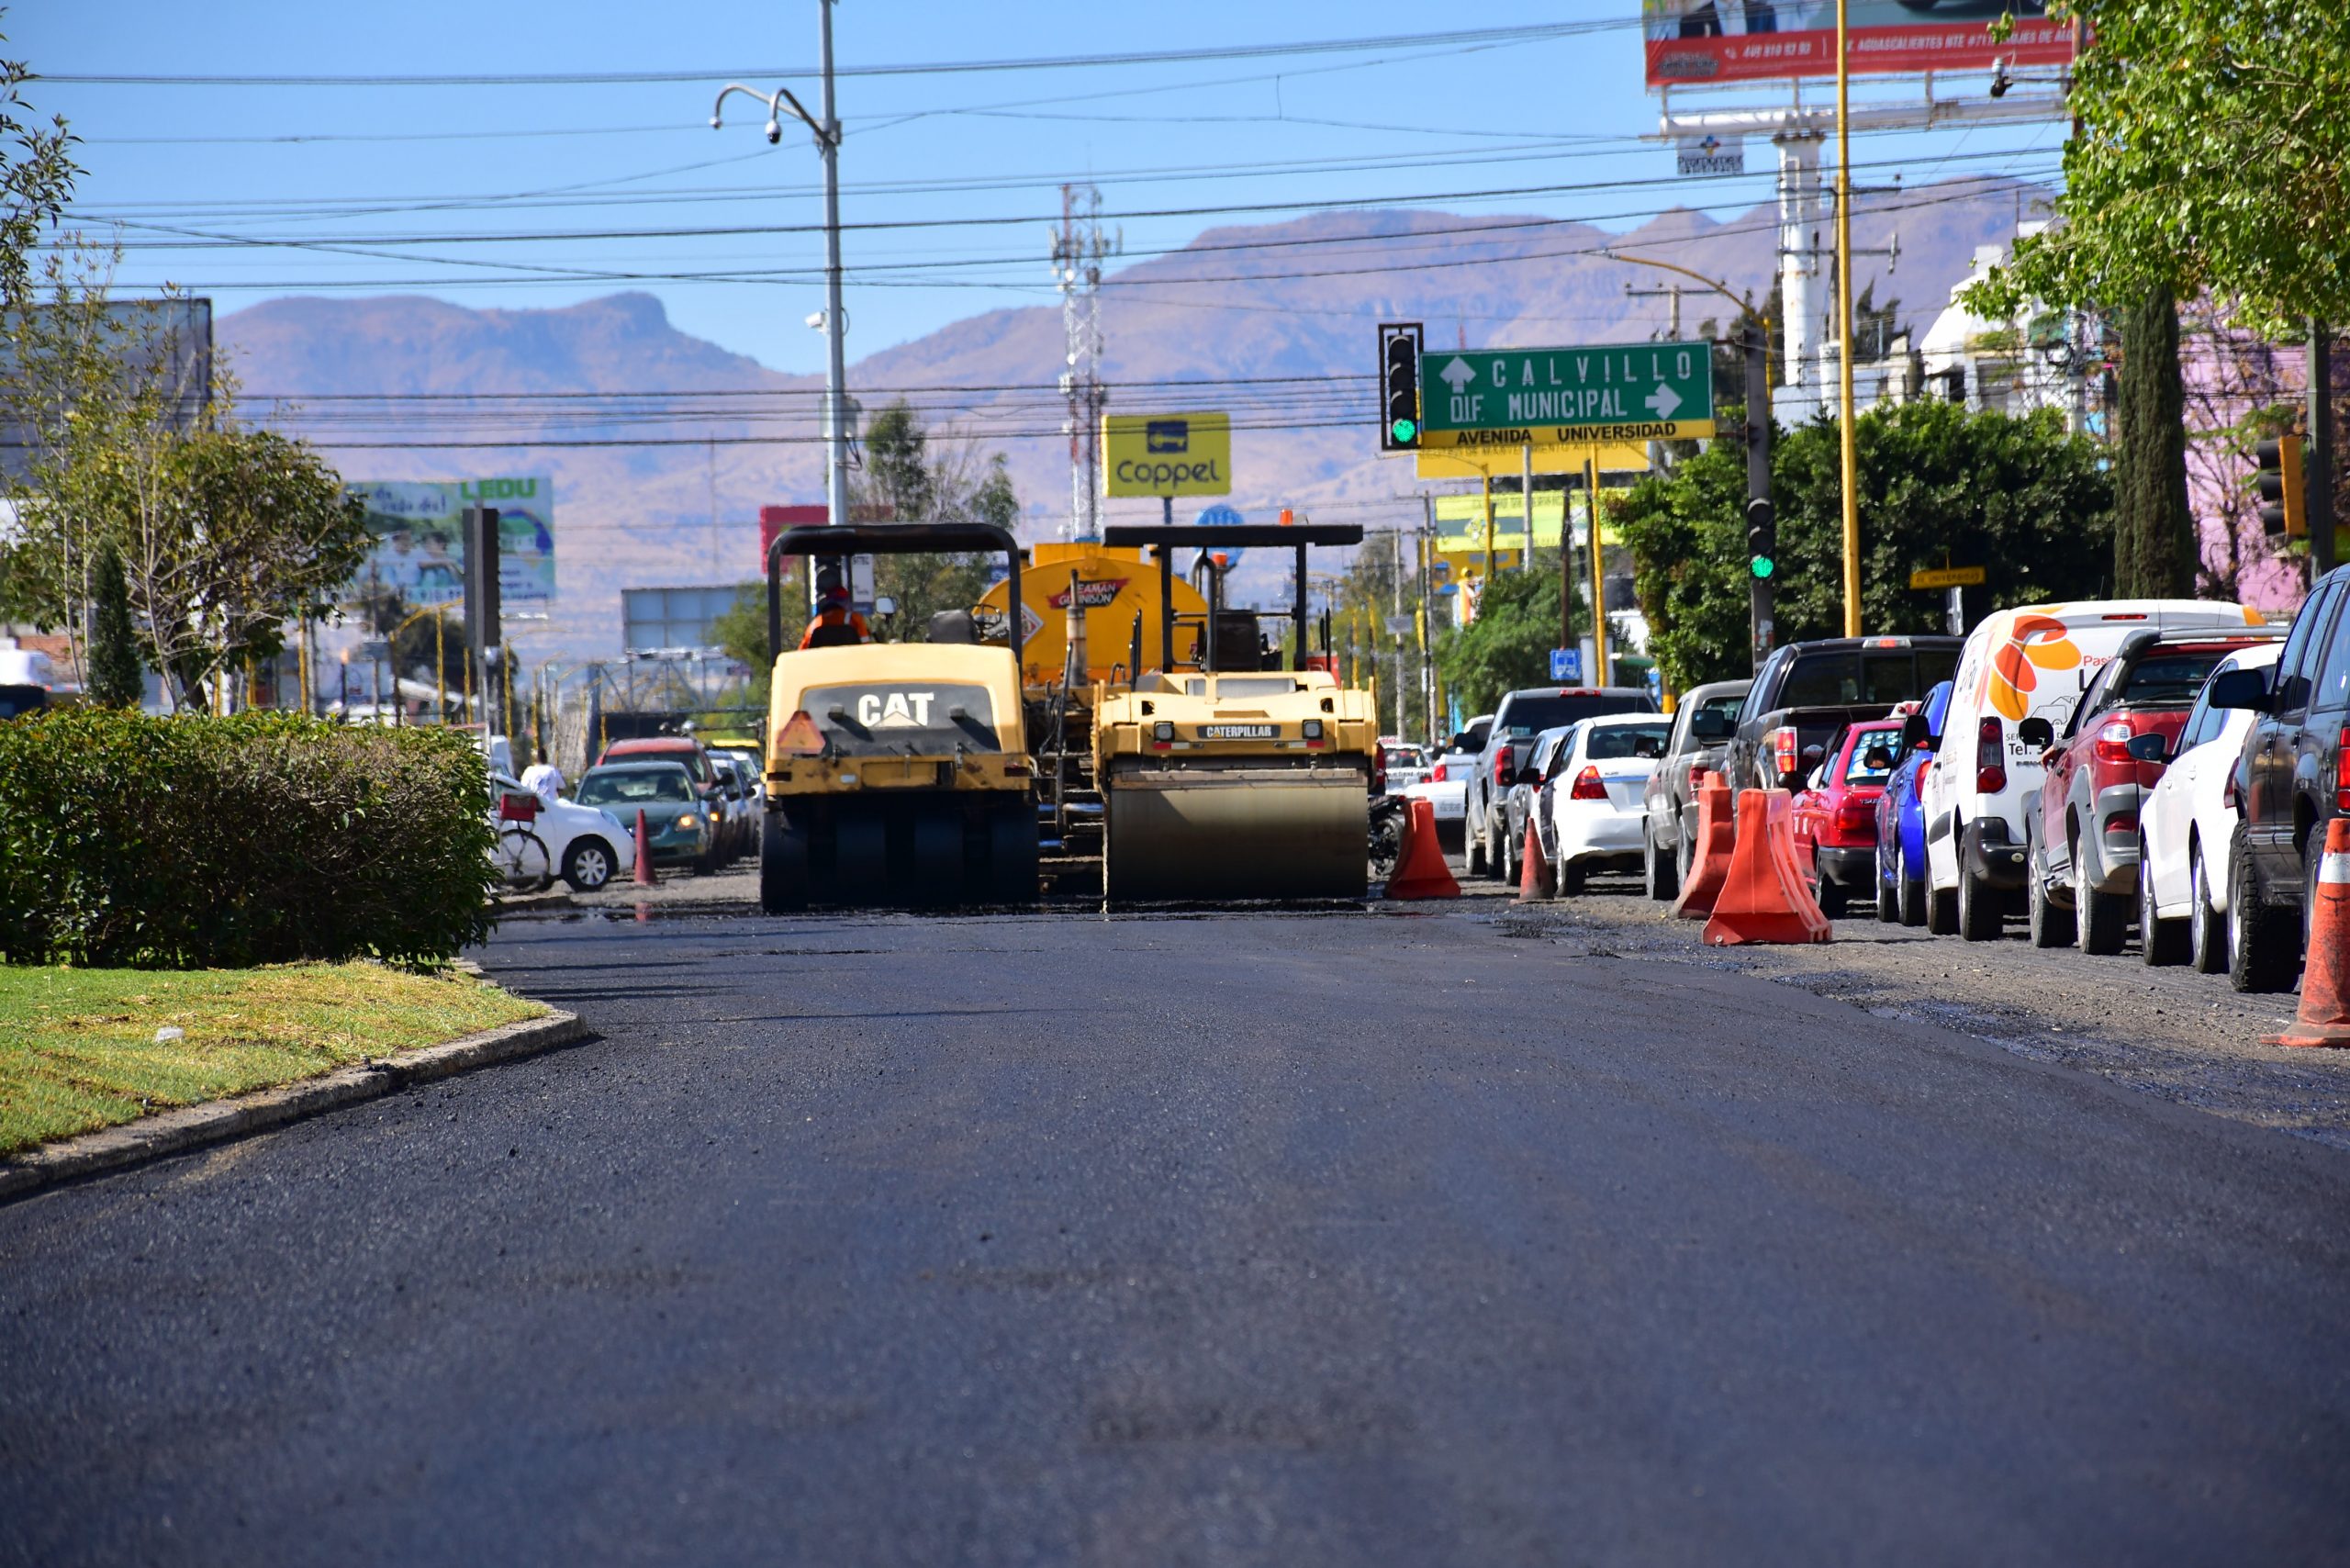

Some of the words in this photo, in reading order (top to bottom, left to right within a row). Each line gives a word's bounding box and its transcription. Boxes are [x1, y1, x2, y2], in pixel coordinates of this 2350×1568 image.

[1492, 351, 1691, 387] CALVILLO
[1508, 387, 1627, 421] MUNICIPAL
[1457, 428, 1533, 445] AVENIDA
[1557, 422, 1676, 442] UNIVERSIDAD
[1116, 459, 1220, 489] Coppel
[461, 478, 537, 499] LEDU
[1058, 594, 1113, 606] GUNISON
[858, 692, 934, 727] CAT
[1206, 725, 1271, 738] CATERPILLAR
